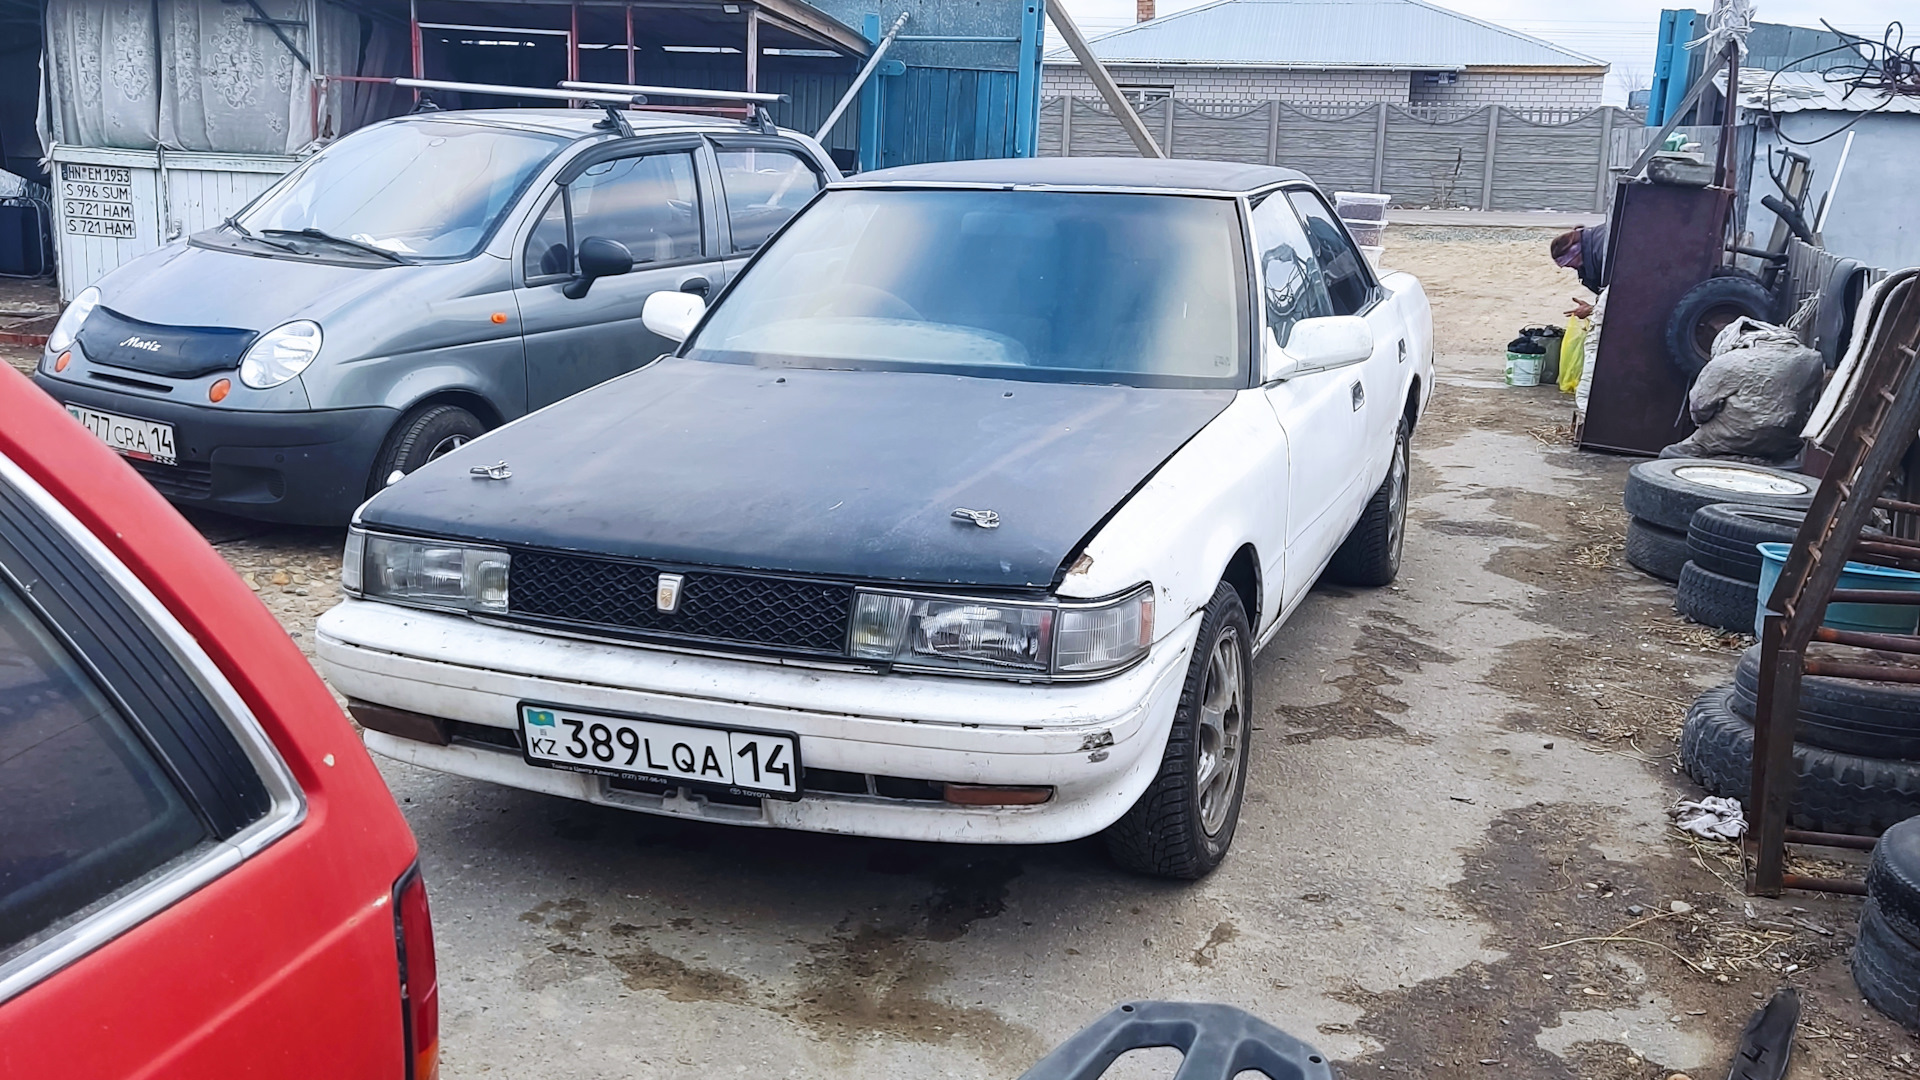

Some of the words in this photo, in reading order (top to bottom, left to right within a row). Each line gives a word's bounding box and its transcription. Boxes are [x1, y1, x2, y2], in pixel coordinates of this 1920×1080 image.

[68, 166, 81, 179] HN
[88, 168, 102, 180] EM
[104, 169, 130, 182] 1953
[66, 183, 74, 196] S
[77, 185, 99, 198] 996
[102, 187, 128, 200] SUM
[67, 201, 75, 214] S
[78, 202, 99, 216] 721
[103, 204, 131, 218] HAM
[69, 219, 77, 232] S
[80, 220, 101, 234] 721
[105, 222, 133, 236] HAM
[119, 336, 162, 352] Matiz
[151, 427, 173, 454] 14
[531, 736, 559, 756] KZ
[737, 741, 791, 786] 14
[742, 790, 771, 798] TOYOTA
